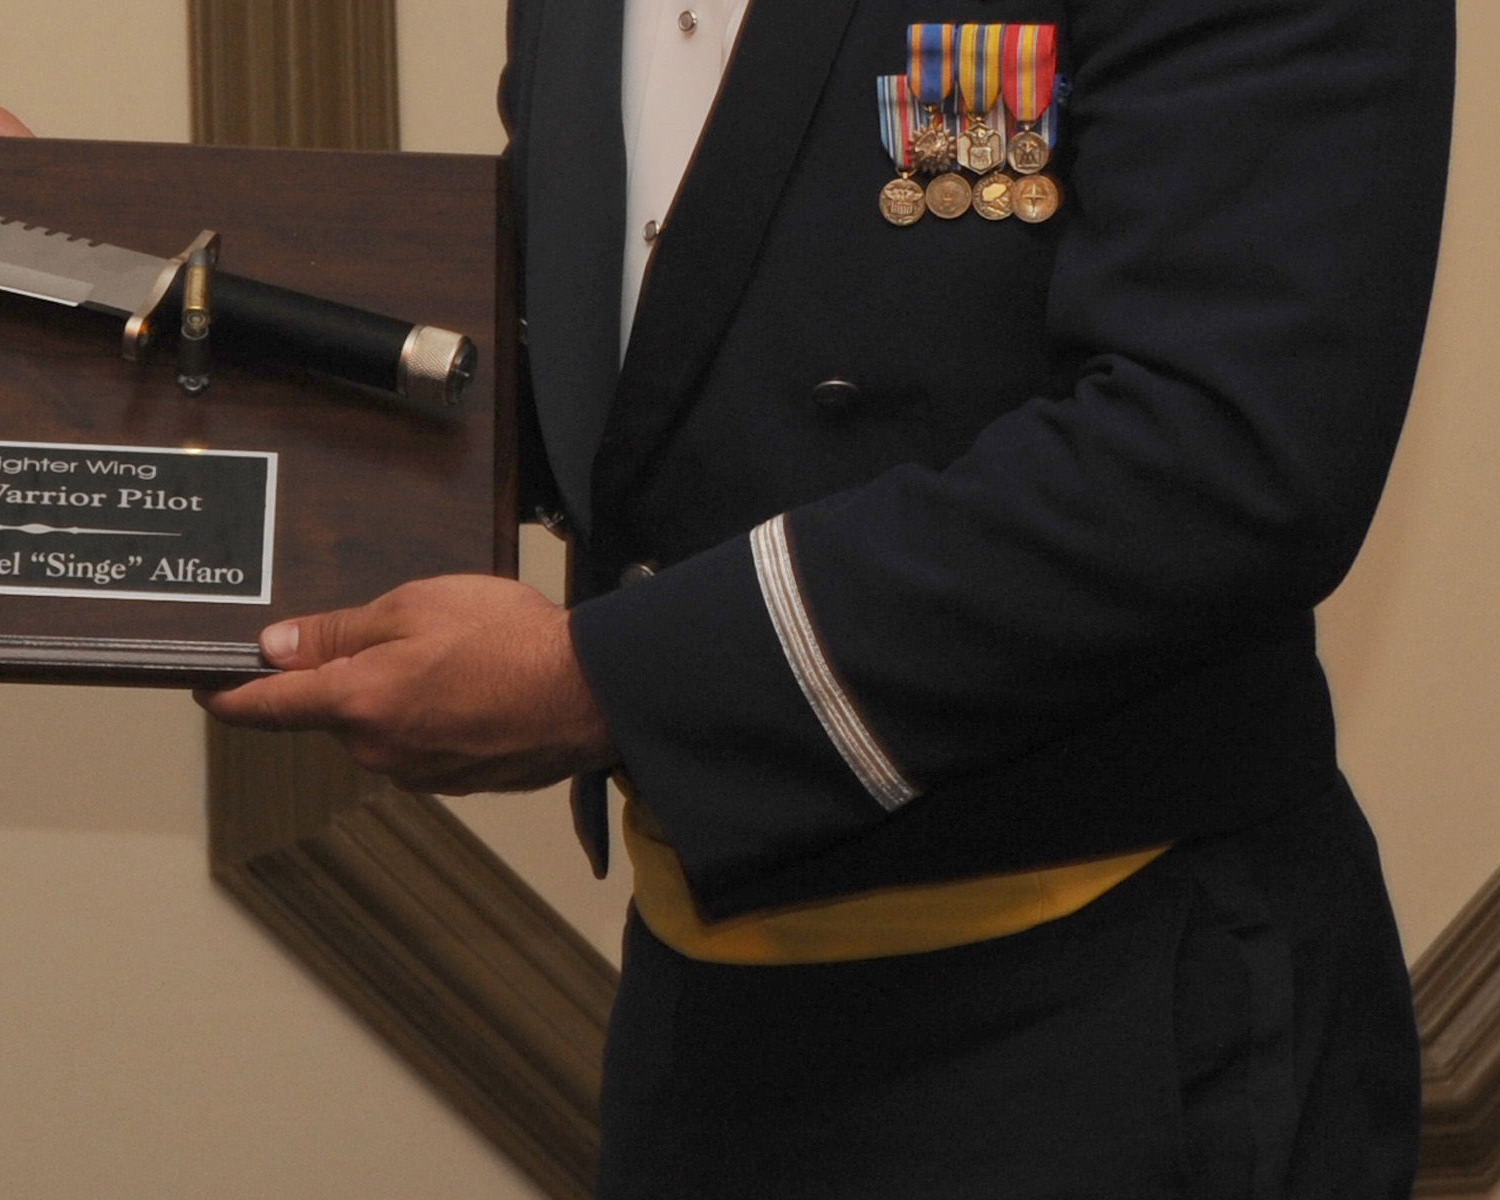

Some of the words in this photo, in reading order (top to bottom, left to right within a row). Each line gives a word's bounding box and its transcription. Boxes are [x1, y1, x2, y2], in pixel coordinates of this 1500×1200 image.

[85, 459, 157, 480] Wing
[117, 488, 203, 512] Pilot
[30, 552, 143, 585] “Singe”
[149, 557, 244, 585] Alfaro
